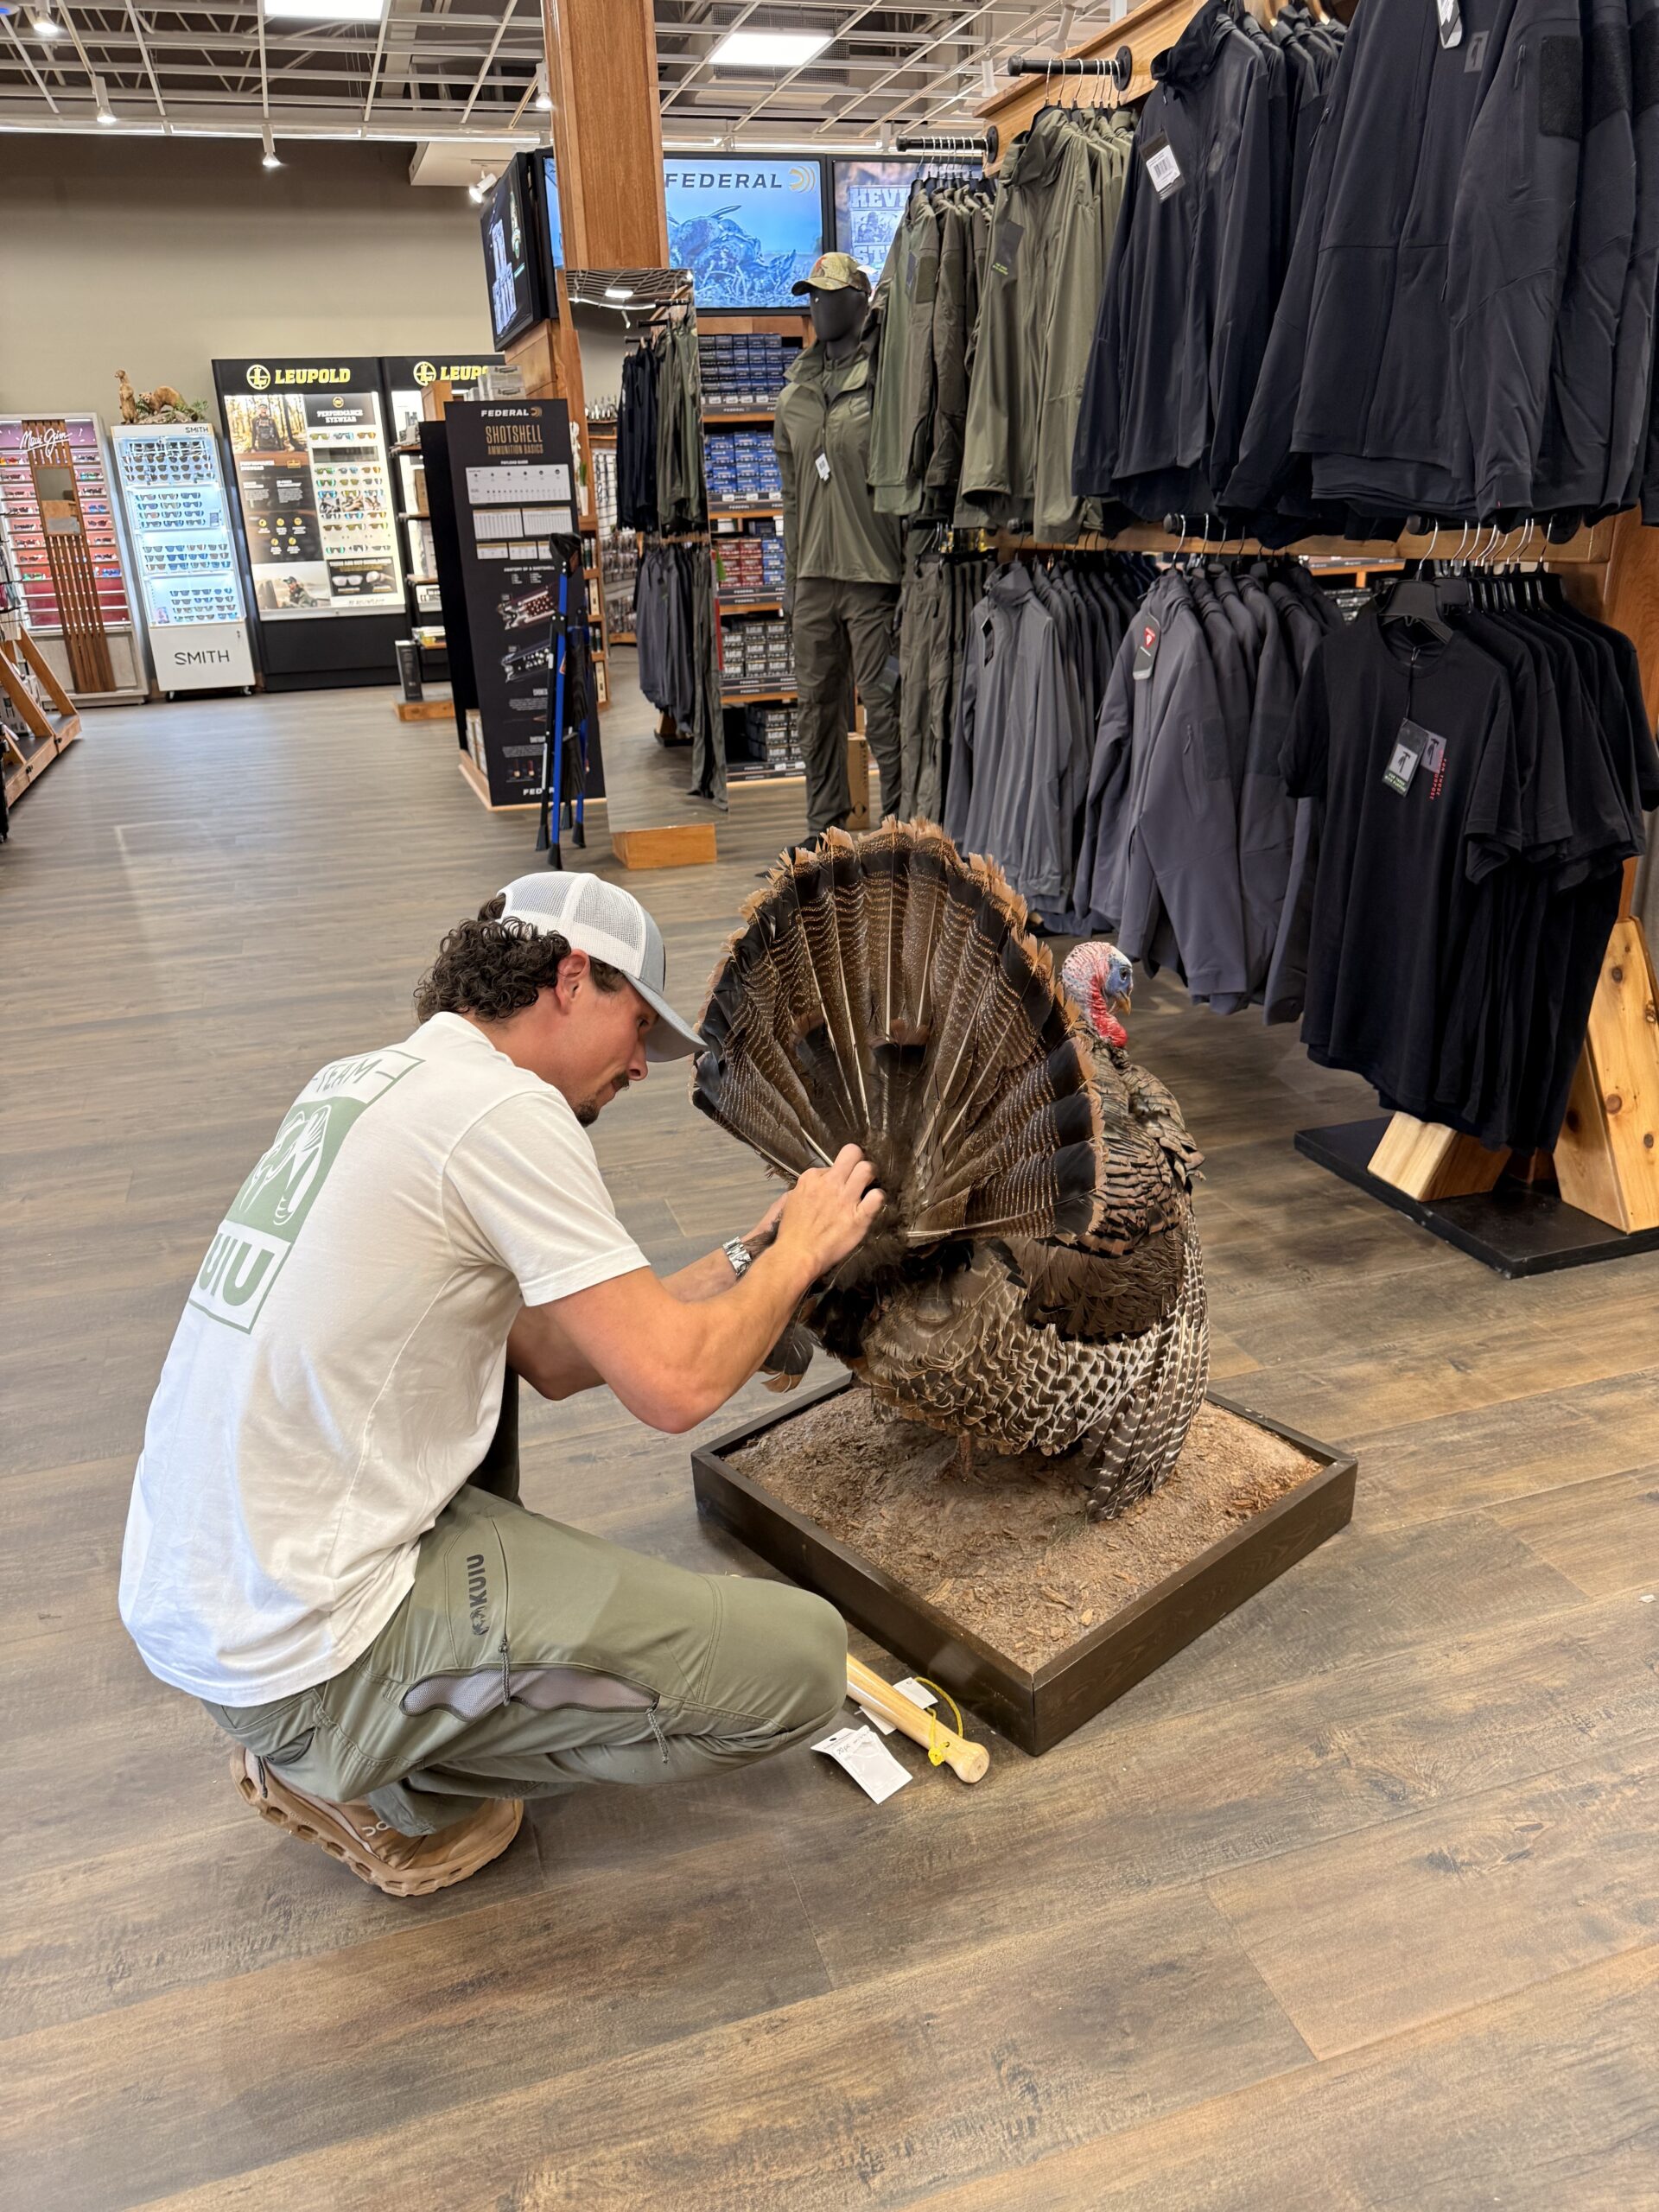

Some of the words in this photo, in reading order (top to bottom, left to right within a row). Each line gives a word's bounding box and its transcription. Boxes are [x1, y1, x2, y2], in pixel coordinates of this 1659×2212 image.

[664, 173, 782, 188] FEDERAL
[274, 368, 351, 385] LEUPOLD
[480, 409, 530, 417] FEDERAL
[20, 430, 43, 449] Maui
[44, 429, 73, 457] Jim
[485, 424, 543, 444] SHOTSHELL
[488, 443, 523, 455] AMMUNITION
[524, 443, 543, 454] BASICS
[174, 650, 230, 665] SMITH
[316, 1058, 383, 1092] TEAM
[200, 1233, 275, 1306] UIU
[467, 1554, 487, 1608] KUIU
